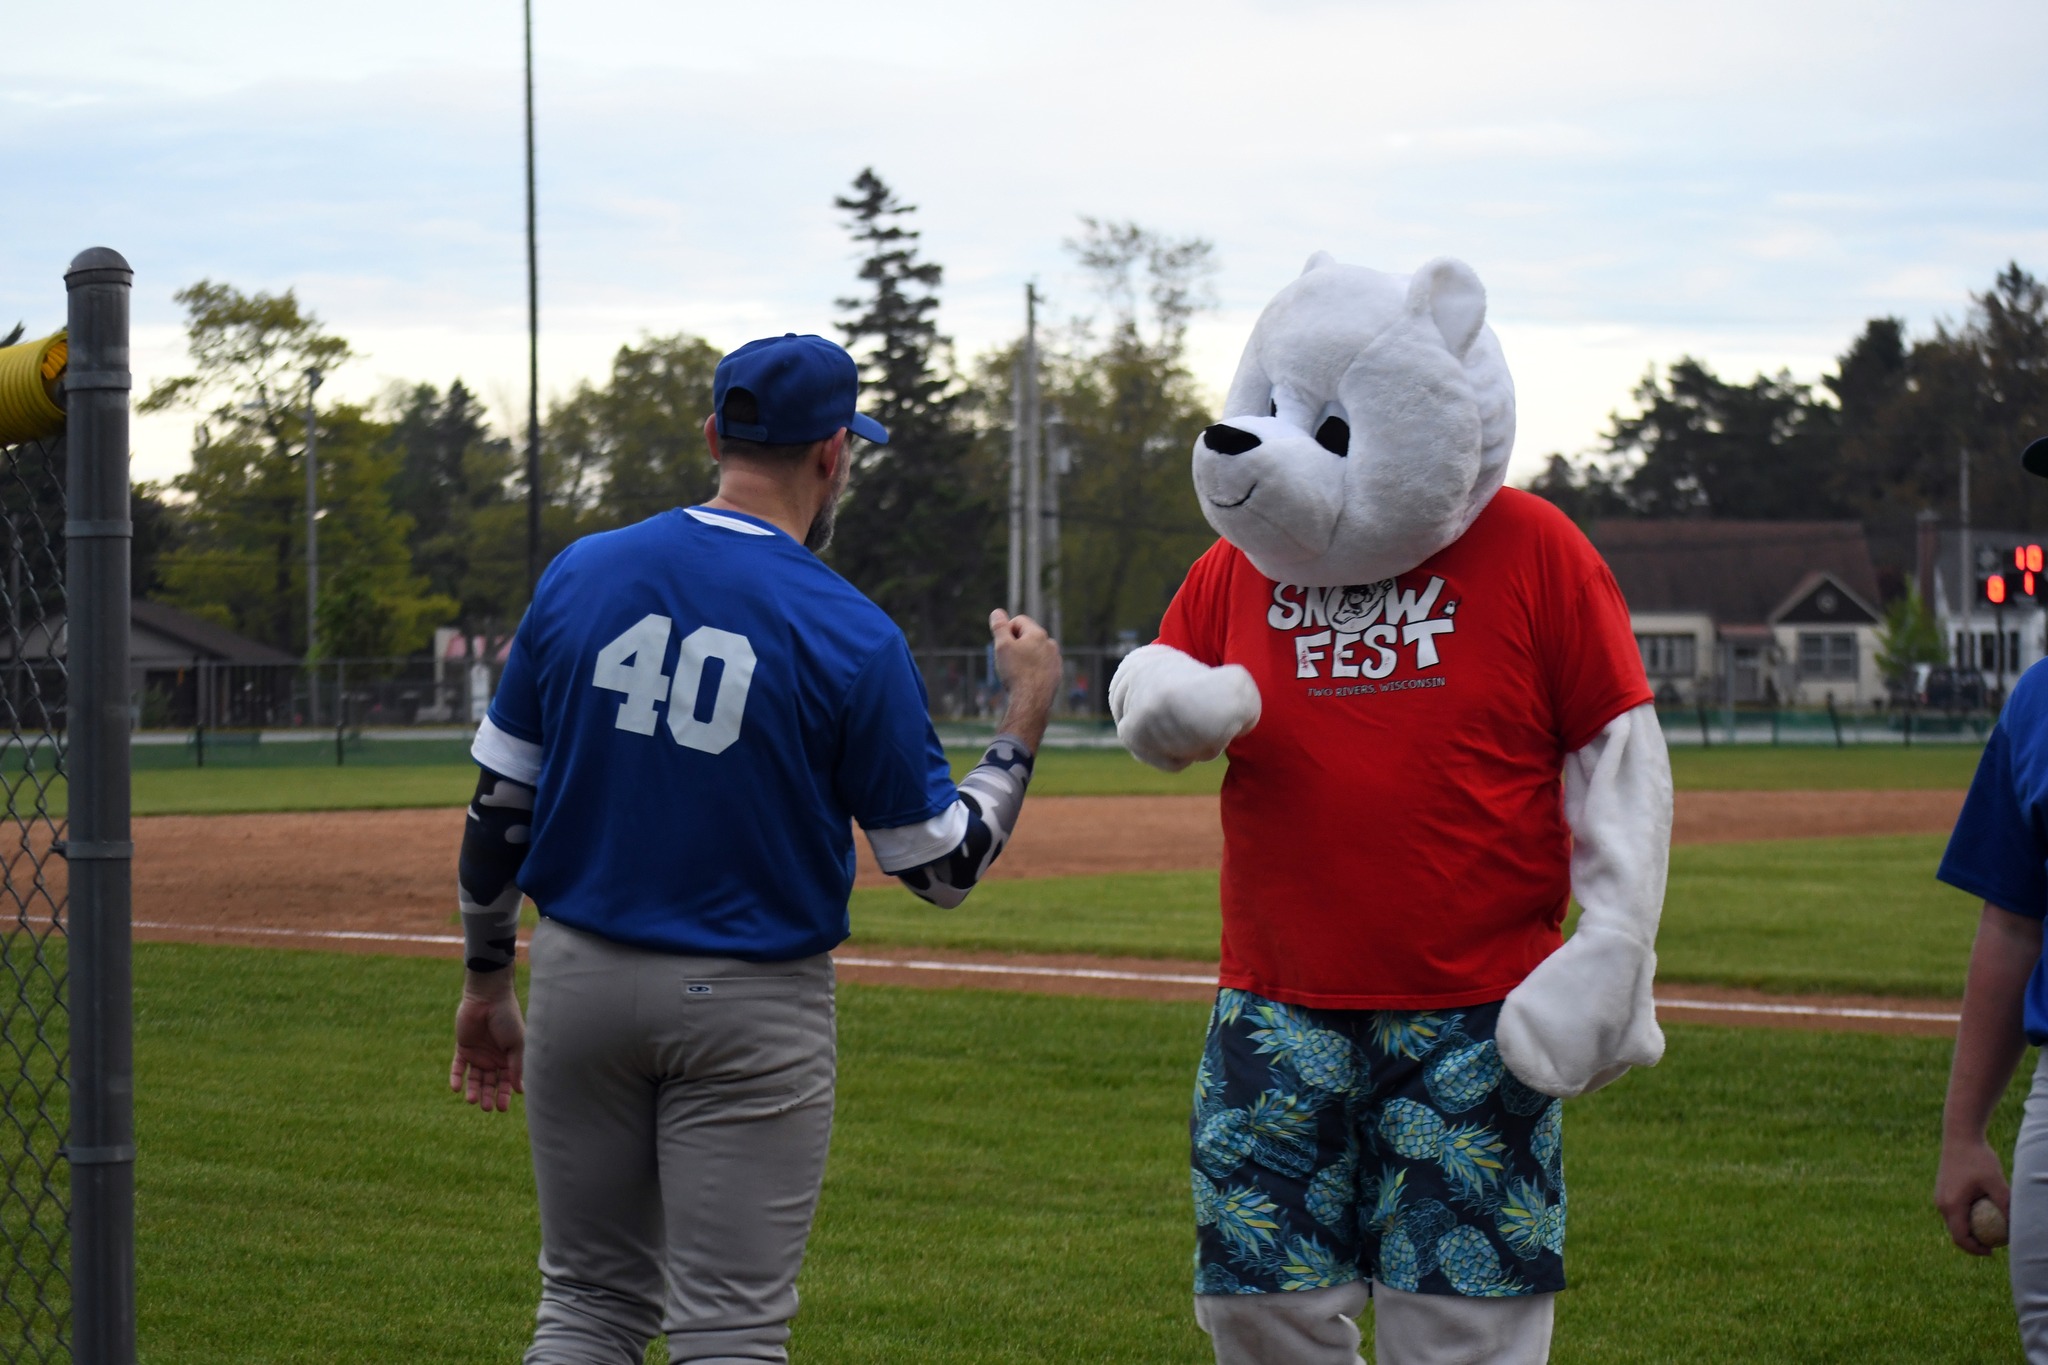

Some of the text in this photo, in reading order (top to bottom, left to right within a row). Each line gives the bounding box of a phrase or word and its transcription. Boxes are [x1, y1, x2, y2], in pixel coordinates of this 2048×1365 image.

[1267, 576, 1446, 634] SNOW
[1294, 618, 1455, 679] FEST
[592, 613, 757, 755] 40
[1307, 677, 1446, 697] TWO RIVERS, WISCONSIN
